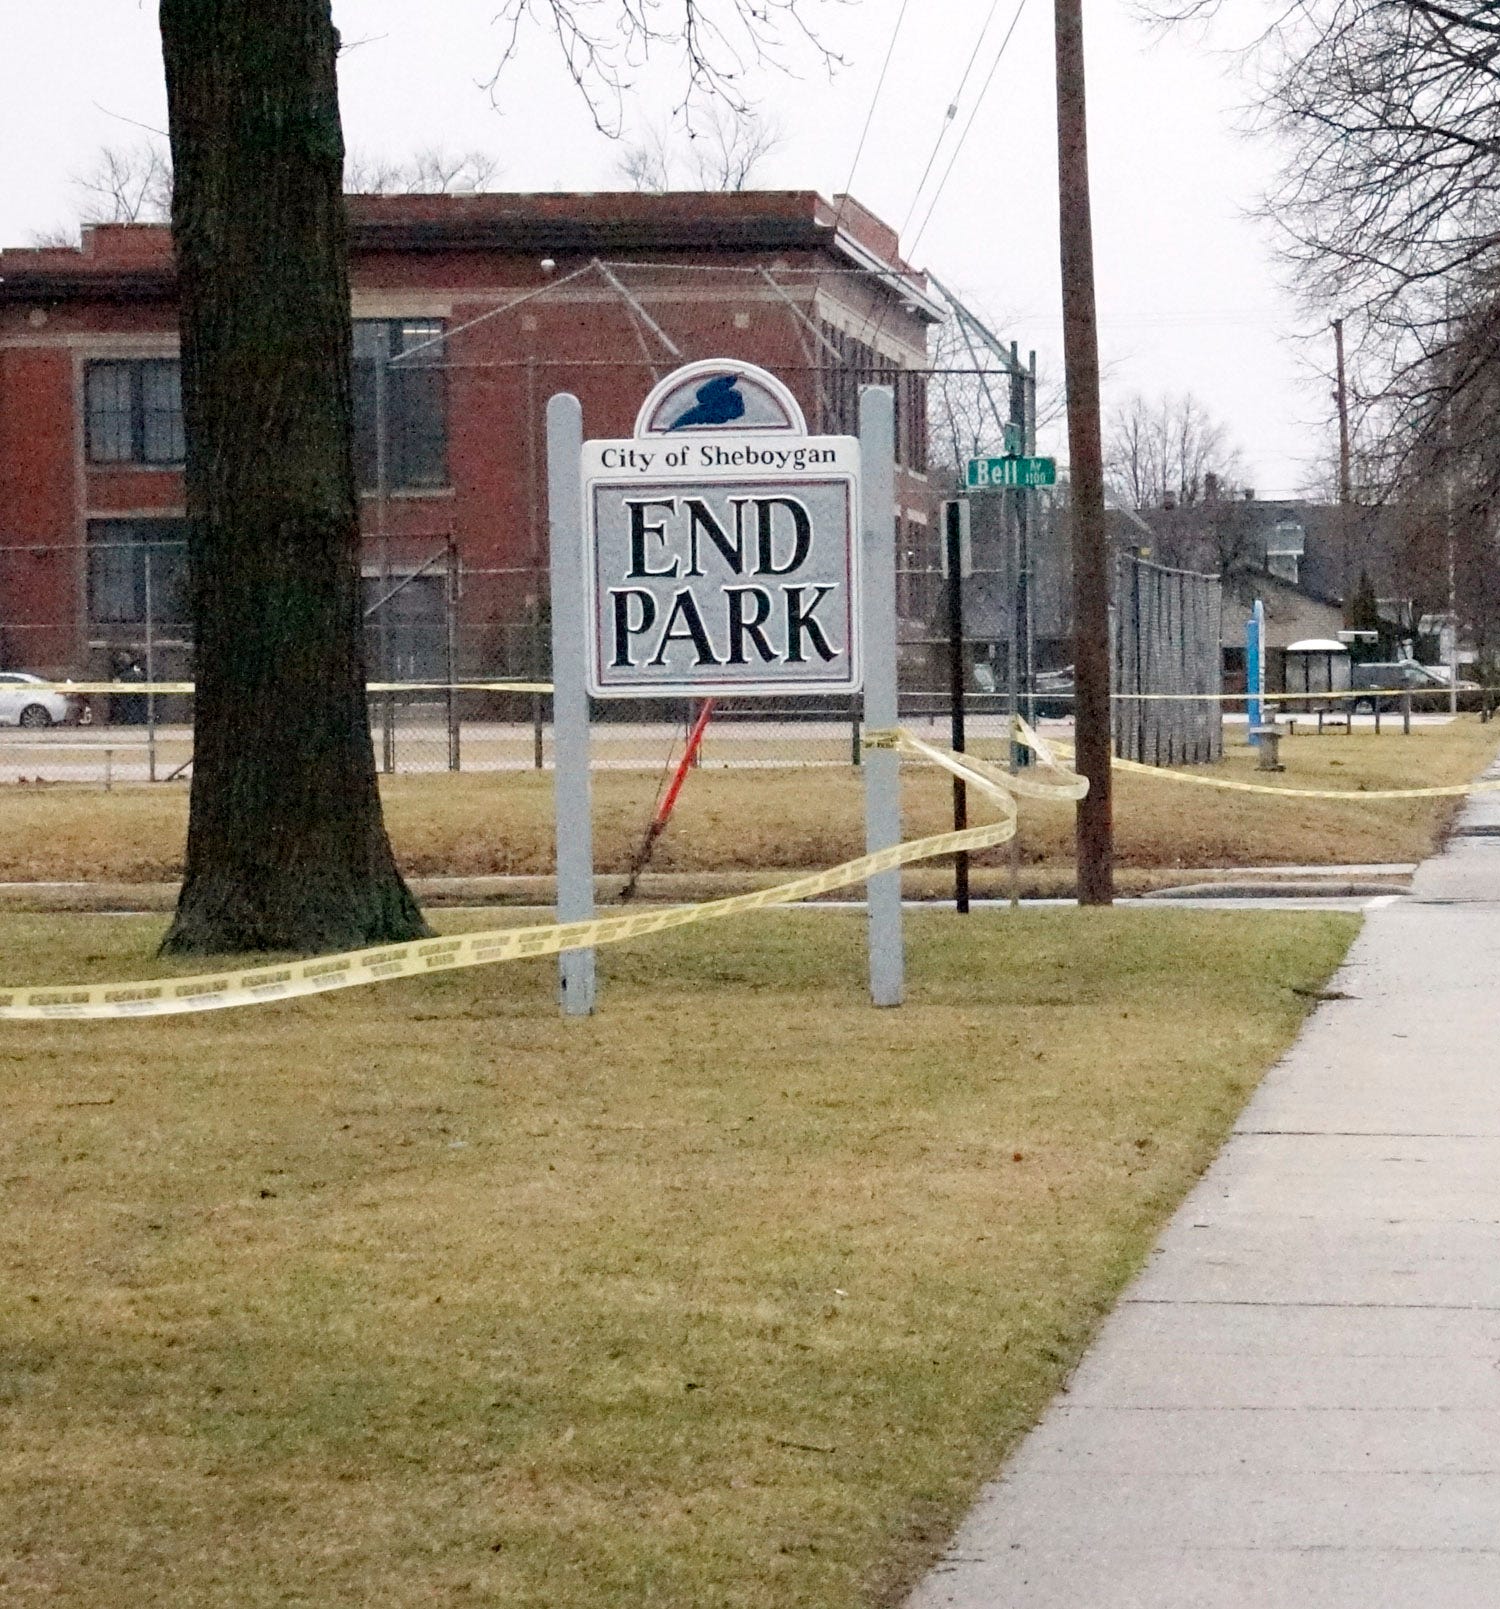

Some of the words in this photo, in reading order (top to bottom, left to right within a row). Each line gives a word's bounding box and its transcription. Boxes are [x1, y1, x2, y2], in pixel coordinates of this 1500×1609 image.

[601, 448, 656, 472] City
[665, 446, 690, 467] of
[700, 445, 837, 470] Sheboygan
[977, 459, 1017, 485] Bell
[624, 496, 812, 580] END
[608, 583, 843, 668] PARK
